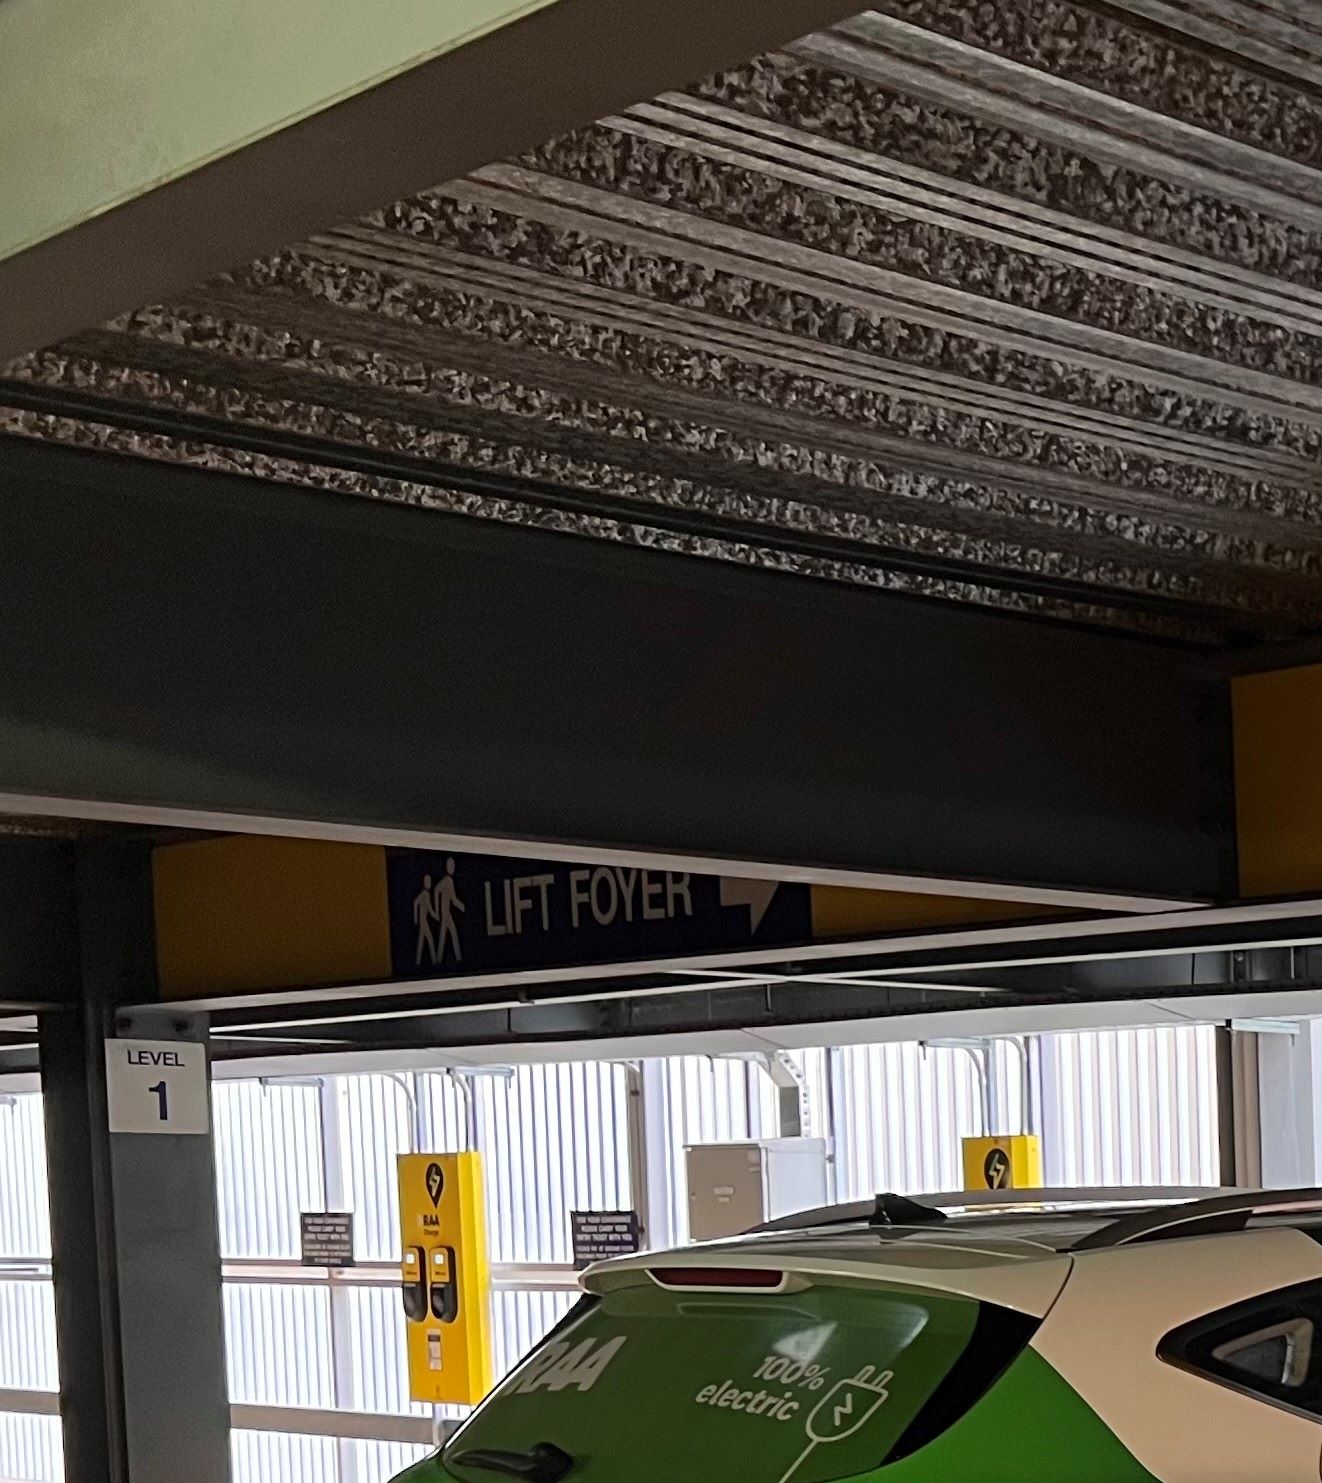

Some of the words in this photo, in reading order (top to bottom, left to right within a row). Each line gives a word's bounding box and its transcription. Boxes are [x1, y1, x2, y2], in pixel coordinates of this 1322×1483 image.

[484, 873, 554, 936] LIFT
[569, 866, 693, 928] FOYER
[127, 1050, 185, 1067] LEVEL
[149, 1081, 168, 1120] 1
[752, 1356, 830, 1391] 100%
[695, 1380, 801, 1421] electric
